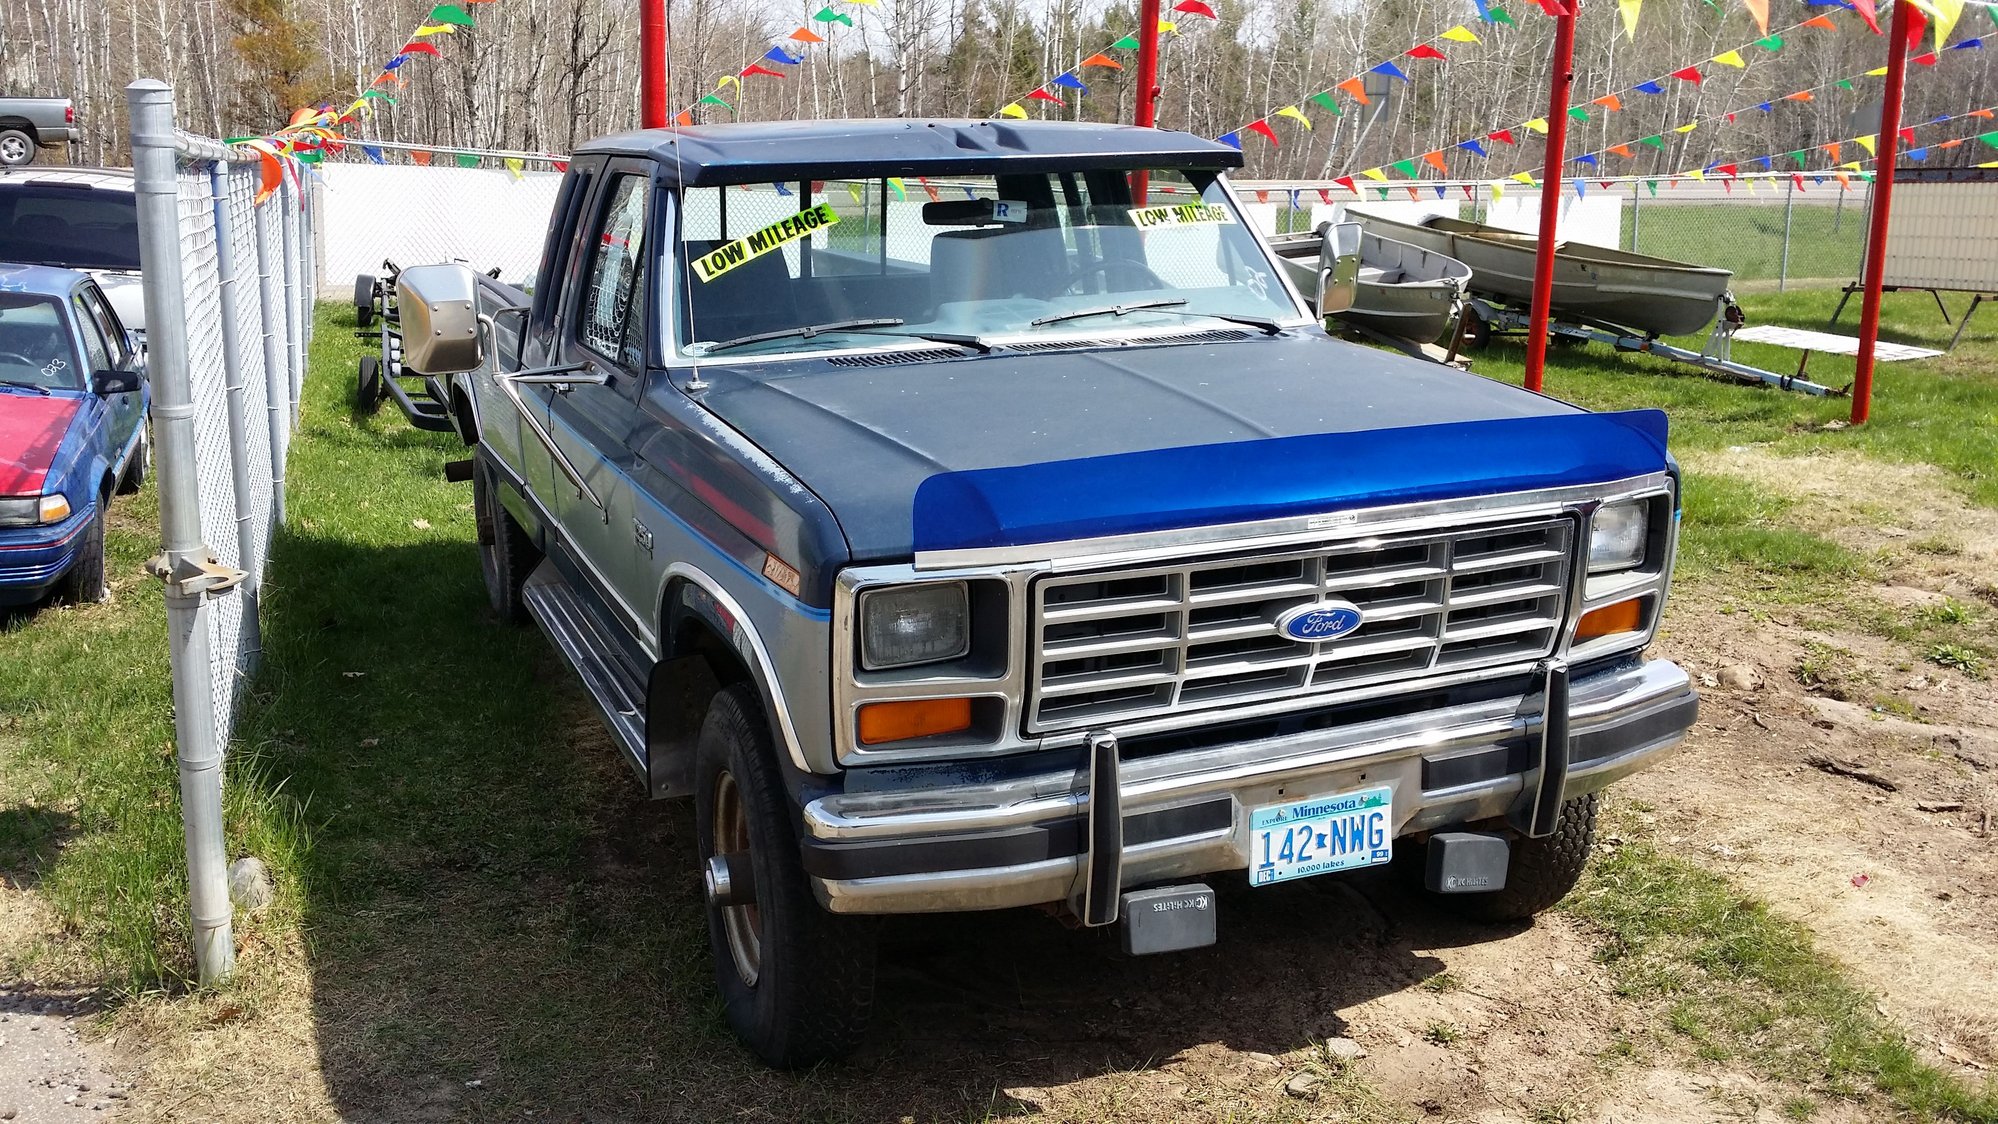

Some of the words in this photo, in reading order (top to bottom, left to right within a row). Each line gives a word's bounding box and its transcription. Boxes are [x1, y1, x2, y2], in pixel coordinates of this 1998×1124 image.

[997, 203, 1009, 217] R
[1136, 208, 1168, 227] LOW
[1171, 205, 1229, 224] MILEAGE
[701, 241, 745, 277] LOW
[747, 206, 829, 254] MILEAGE
[1302, 612, 1346, 634] Ford
[1292, 799, 1356, 819] Minnesota
[1258, 825, 1313, 869] 142
[1330, 812, 1384, 857] NWG
[1322, 859, 1345, 870] lakes
[1258, 870, 1271, 882] DEC
